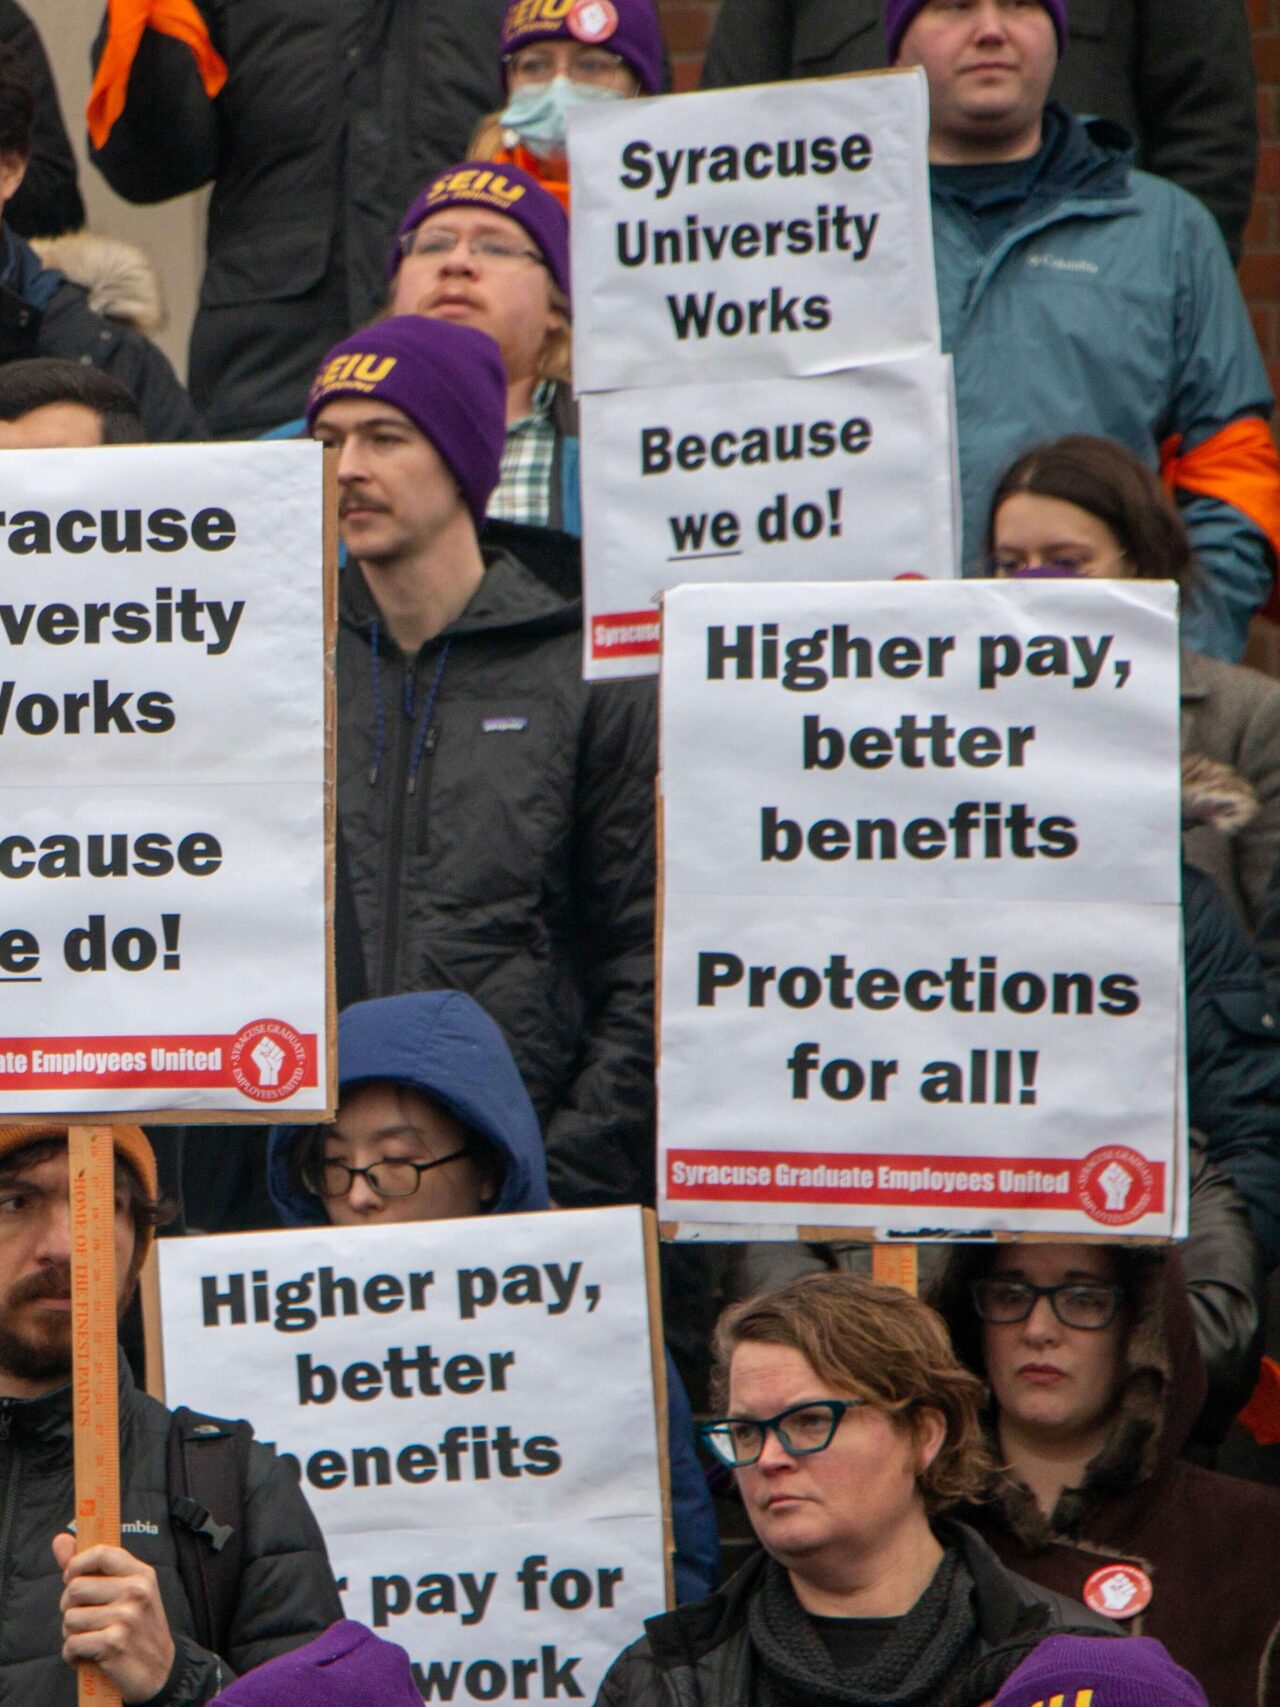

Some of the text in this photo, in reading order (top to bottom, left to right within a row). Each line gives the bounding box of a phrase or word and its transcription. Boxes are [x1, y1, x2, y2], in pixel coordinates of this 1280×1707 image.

[619, 133, 873, 199] Syracuse
[616, 204, 879, 268] University
[667, 288, 830, 340] Works
[641, 418, 871, 475] Because
[669, 489, 841, 552] we do!
[707, 624, 1129, 692] Higher pay,
[803, 715, 1035, 770] better
[761, 802, 1078, 861] benefits
[63, 914, 181, 972] do!
[697, 952, 1140, 1016] Protections
[32, 1048, 147, 1075] Employees
[151, 1047, 222, 1072] United
[787, 1043, 1038, 1105] for all!
[671, 1161, 1070, 1194] Syracuse Graduate Employees United
[74, 1176, 91, 1427] HOME OF THE FINEST PAINTS
[201, 1262, 600, 1332] Higher pay,
[296, 1345, 514, 1405] better
[122, 1520, 159, 1535] mbia
[371, 1555, 623, 1627] pay for
[410, 1645, 585, 1702] work
